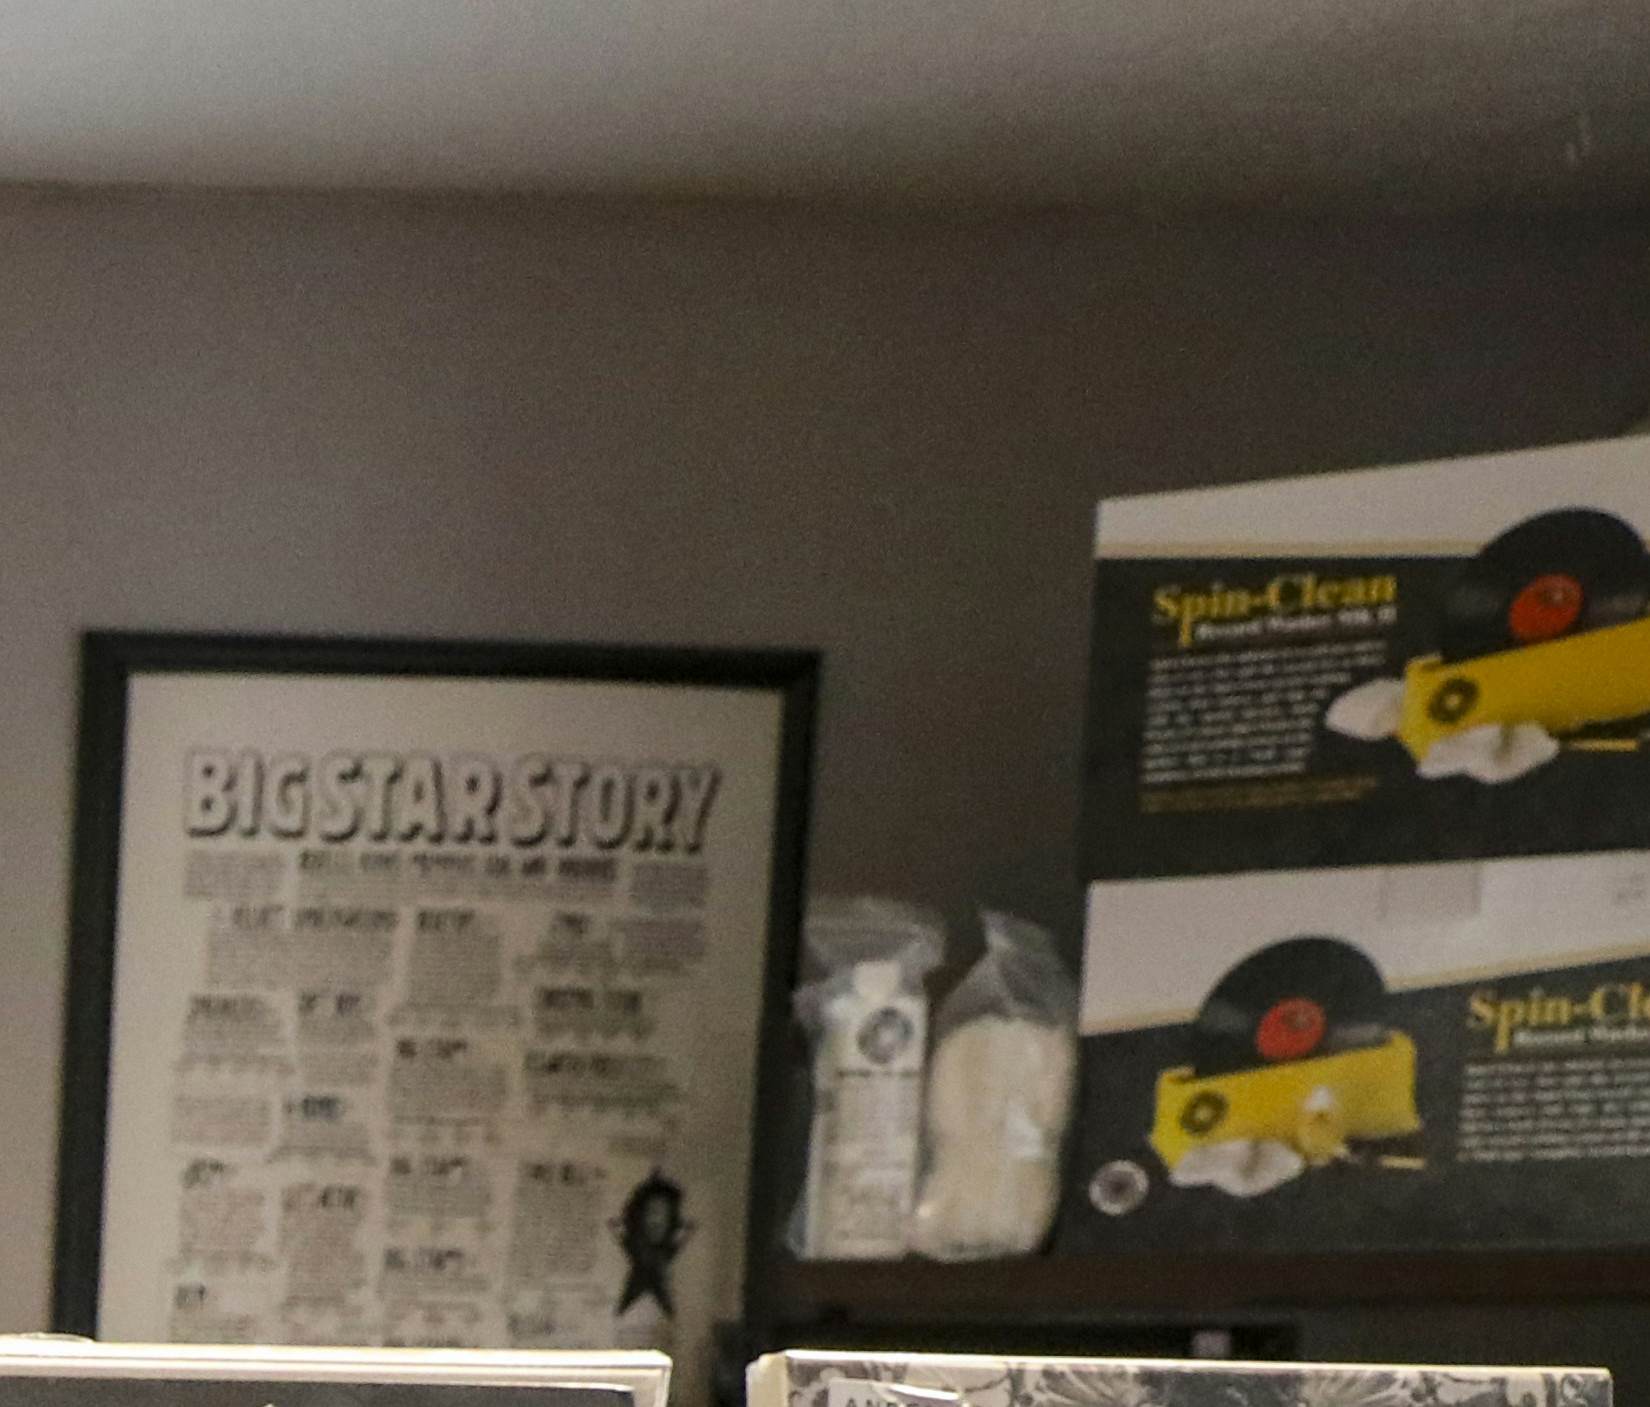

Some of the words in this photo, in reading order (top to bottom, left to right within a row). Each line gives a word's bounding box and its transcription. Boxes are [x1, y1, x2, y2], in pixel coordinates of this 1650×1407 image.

[1154, 573, 1398, 648] Spin-Clean
[185, 750, 310, 839] BIG
[317, 750, 506, 846] STAR
[509, 754, 723, 855] STORY
